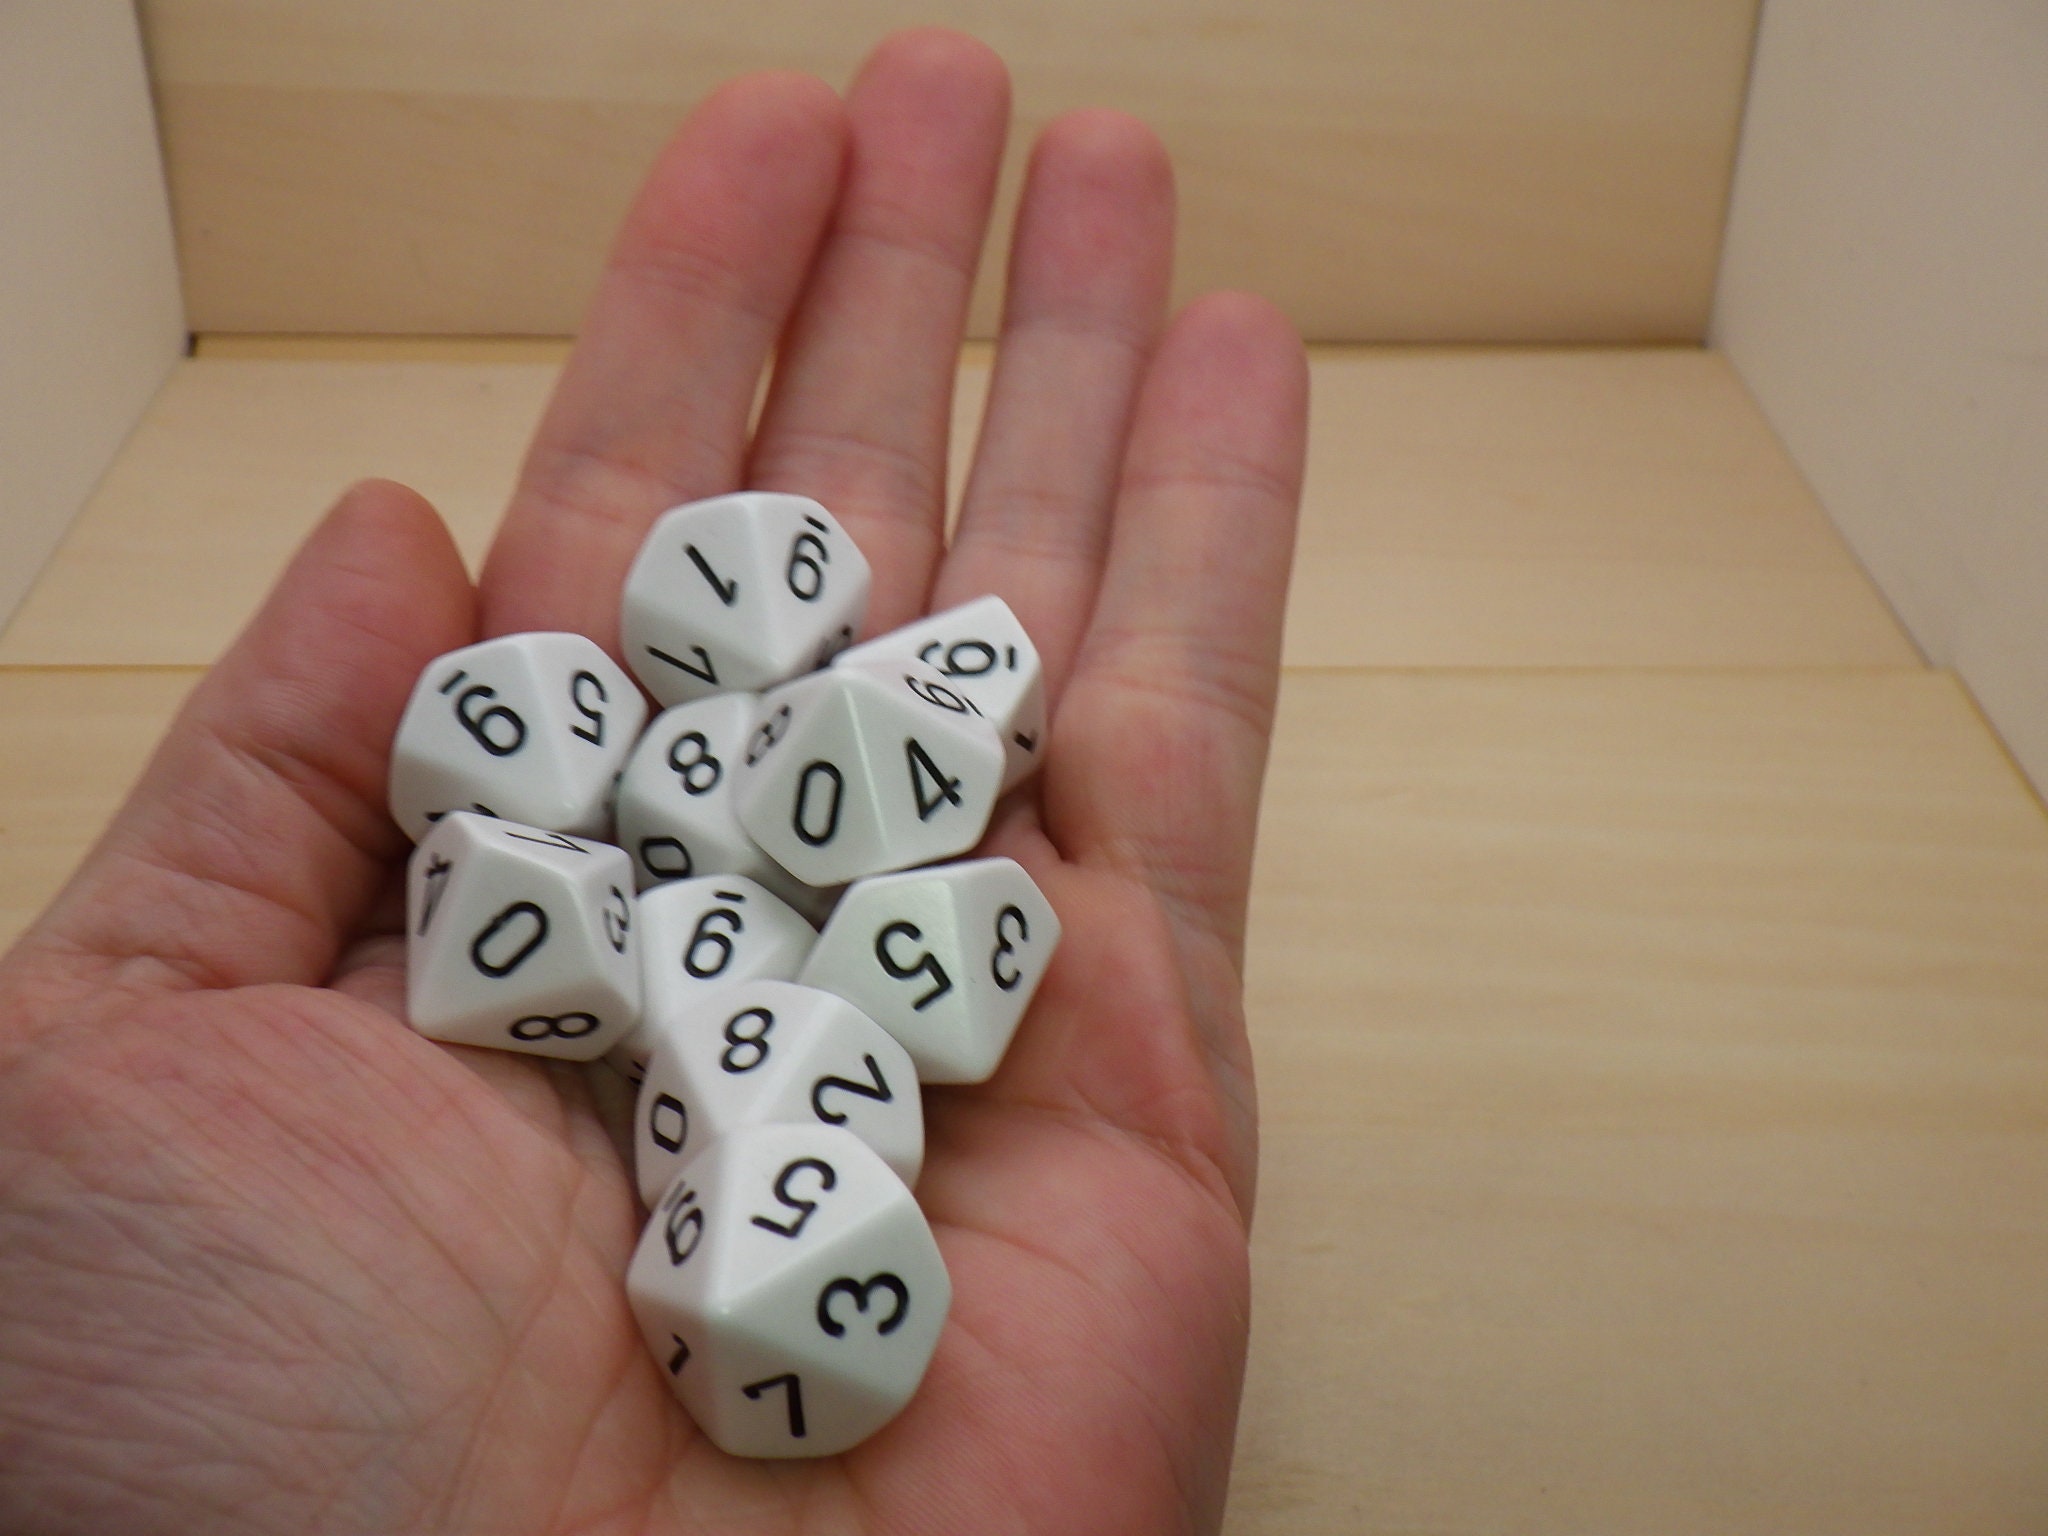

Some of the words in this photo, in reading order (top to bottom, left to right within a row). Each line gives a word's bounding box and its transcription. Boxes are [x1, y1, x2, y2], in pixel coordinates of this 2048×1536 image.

[682, 541, 740, 608] 1
[569, 669, 608, 748] 5
[667, 729, 723, 797] 8
[904, 736, 963, 824] 4
[791, 757, 844, 848] 0
[638, 834, 694, 879] 0
[470, 900, 549, 979] 0
[874, 919, 954, 1013] 5
[991, 903, 1030, 992] 3
[508, 1010, 602, 1043] 8
[719, 1004, 776, 1075] 8
[649, 1090, 689, 1156] 0
[810, 1051, 894, 1127] 2
[750, 1156, 839, 1240] 5
[815, 1271, 912, 1341] 3
[740, 1371, 808, 1440] 7
